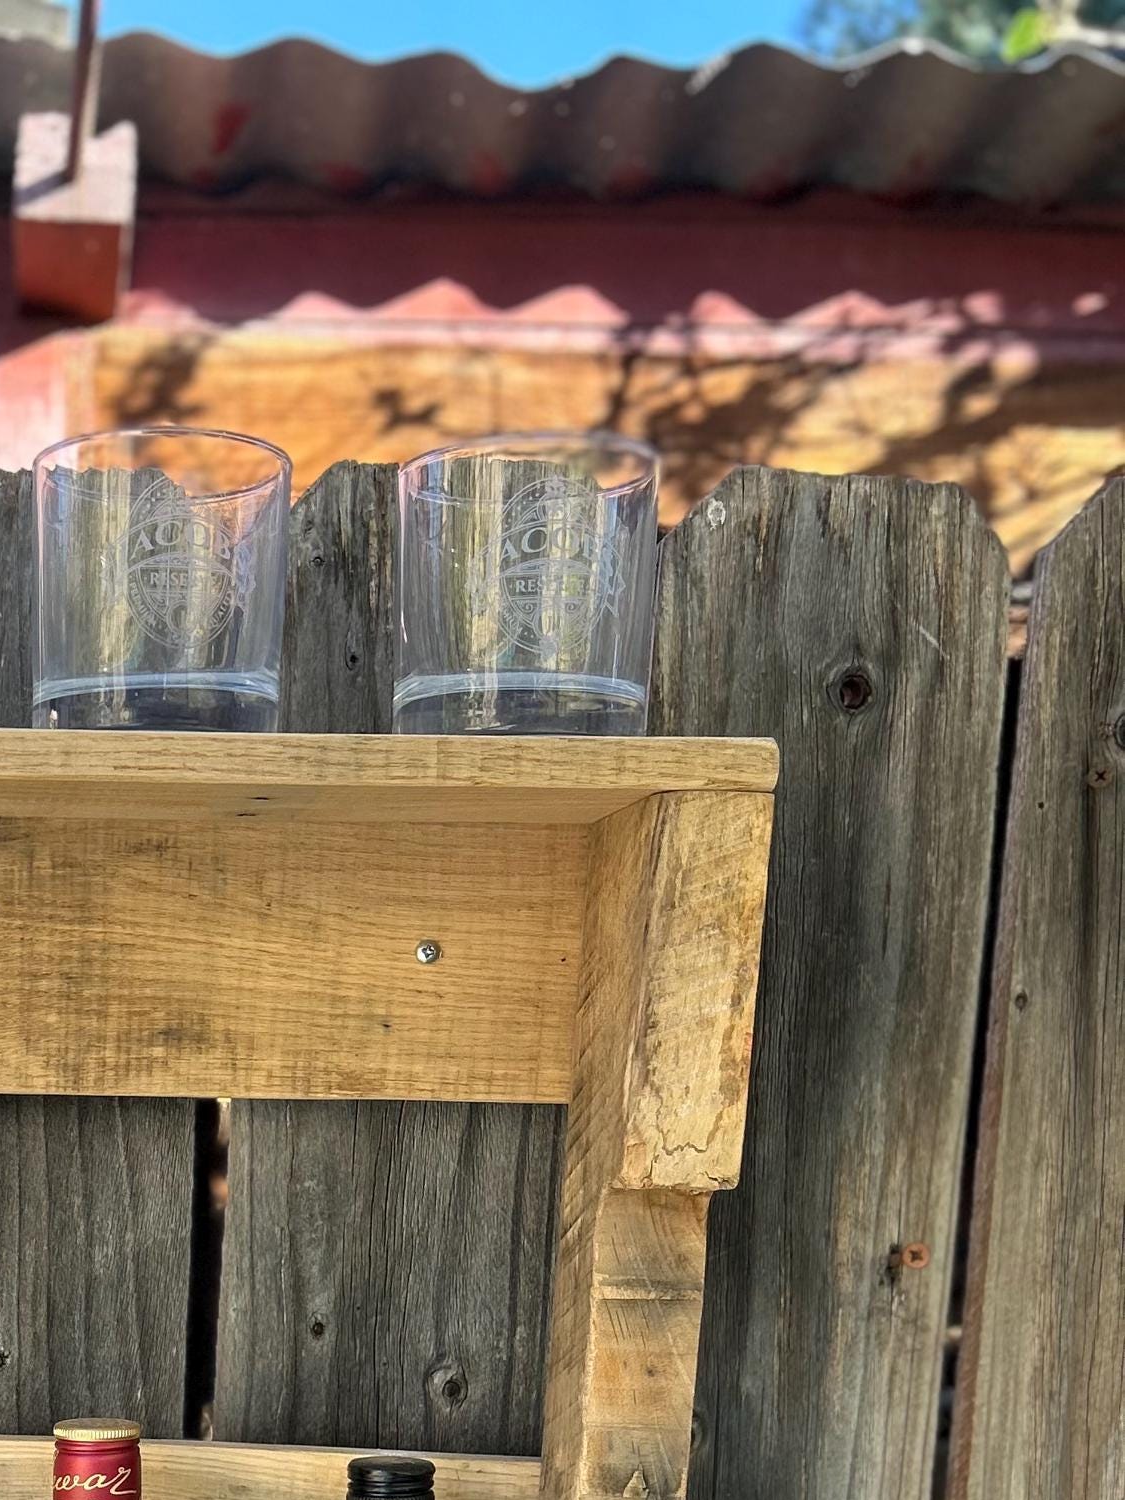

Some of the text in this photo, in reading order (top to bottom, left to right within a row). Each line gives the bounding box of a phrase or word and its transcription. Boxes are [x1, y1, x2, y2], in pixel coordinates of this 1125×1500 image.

[123, 521, 232, 561] ACOB
[149, 572, 221, 587] RSEE
[209, 590, 234, 628] UALITY
[52, 1466, 137, 1495] war
